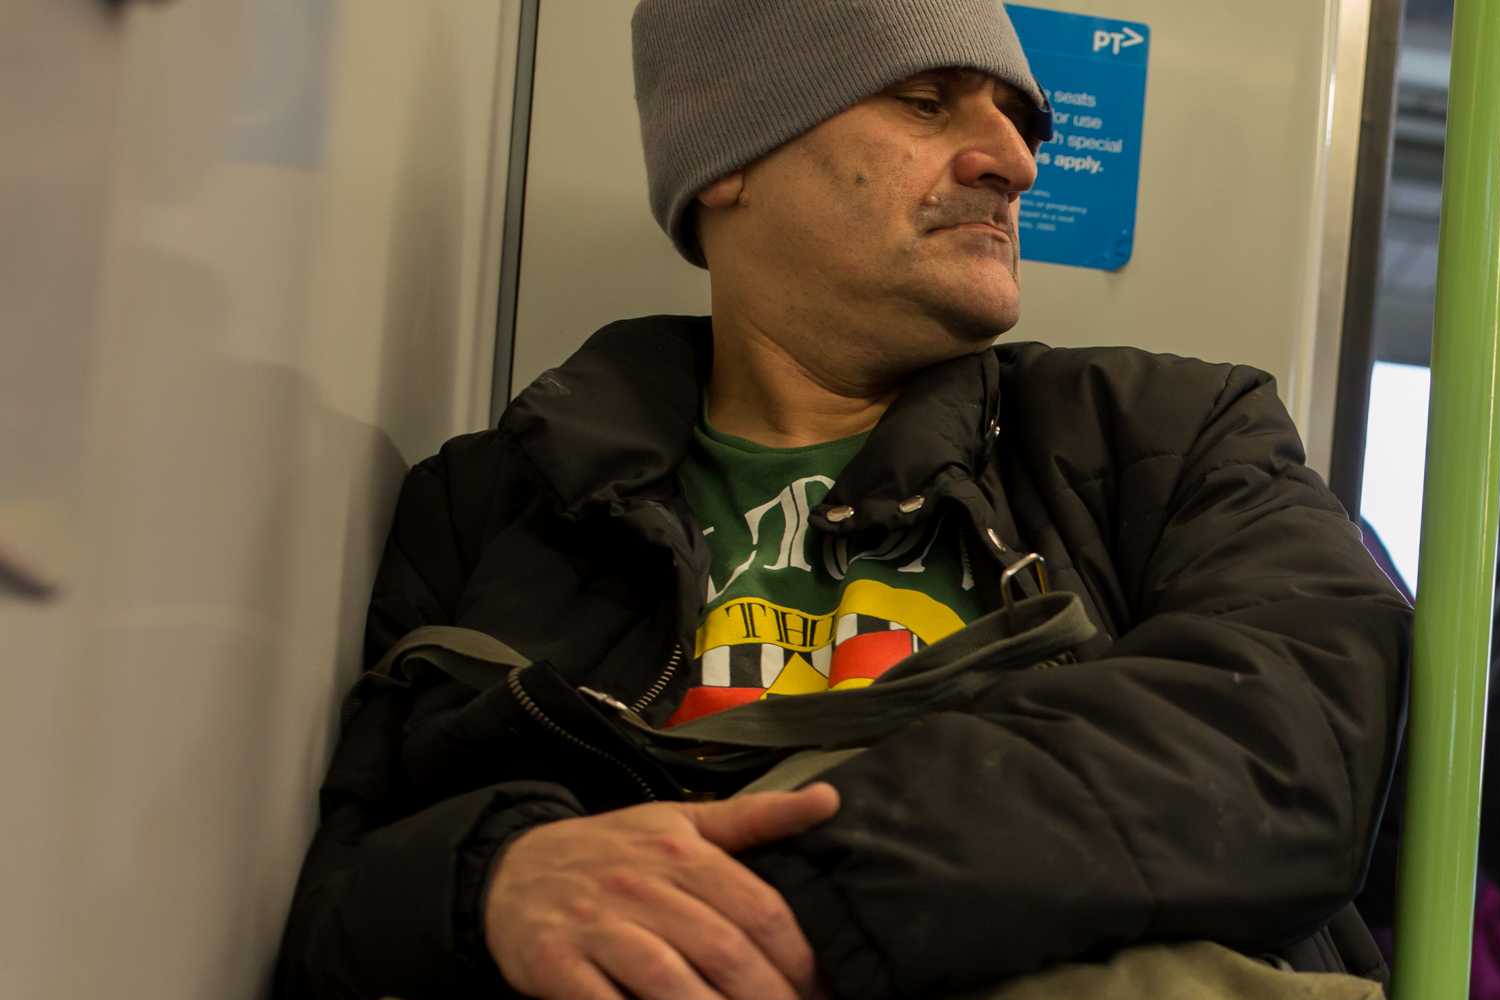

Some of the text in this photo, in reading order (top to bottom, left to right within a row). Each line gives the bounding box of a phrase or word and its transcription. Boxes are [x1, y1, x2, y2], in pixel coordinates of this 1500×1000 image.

[1054, 90, 1096, 108] seats
[1073, 114, 1103, 131] use
[1068, 135, 1123, 153] special
